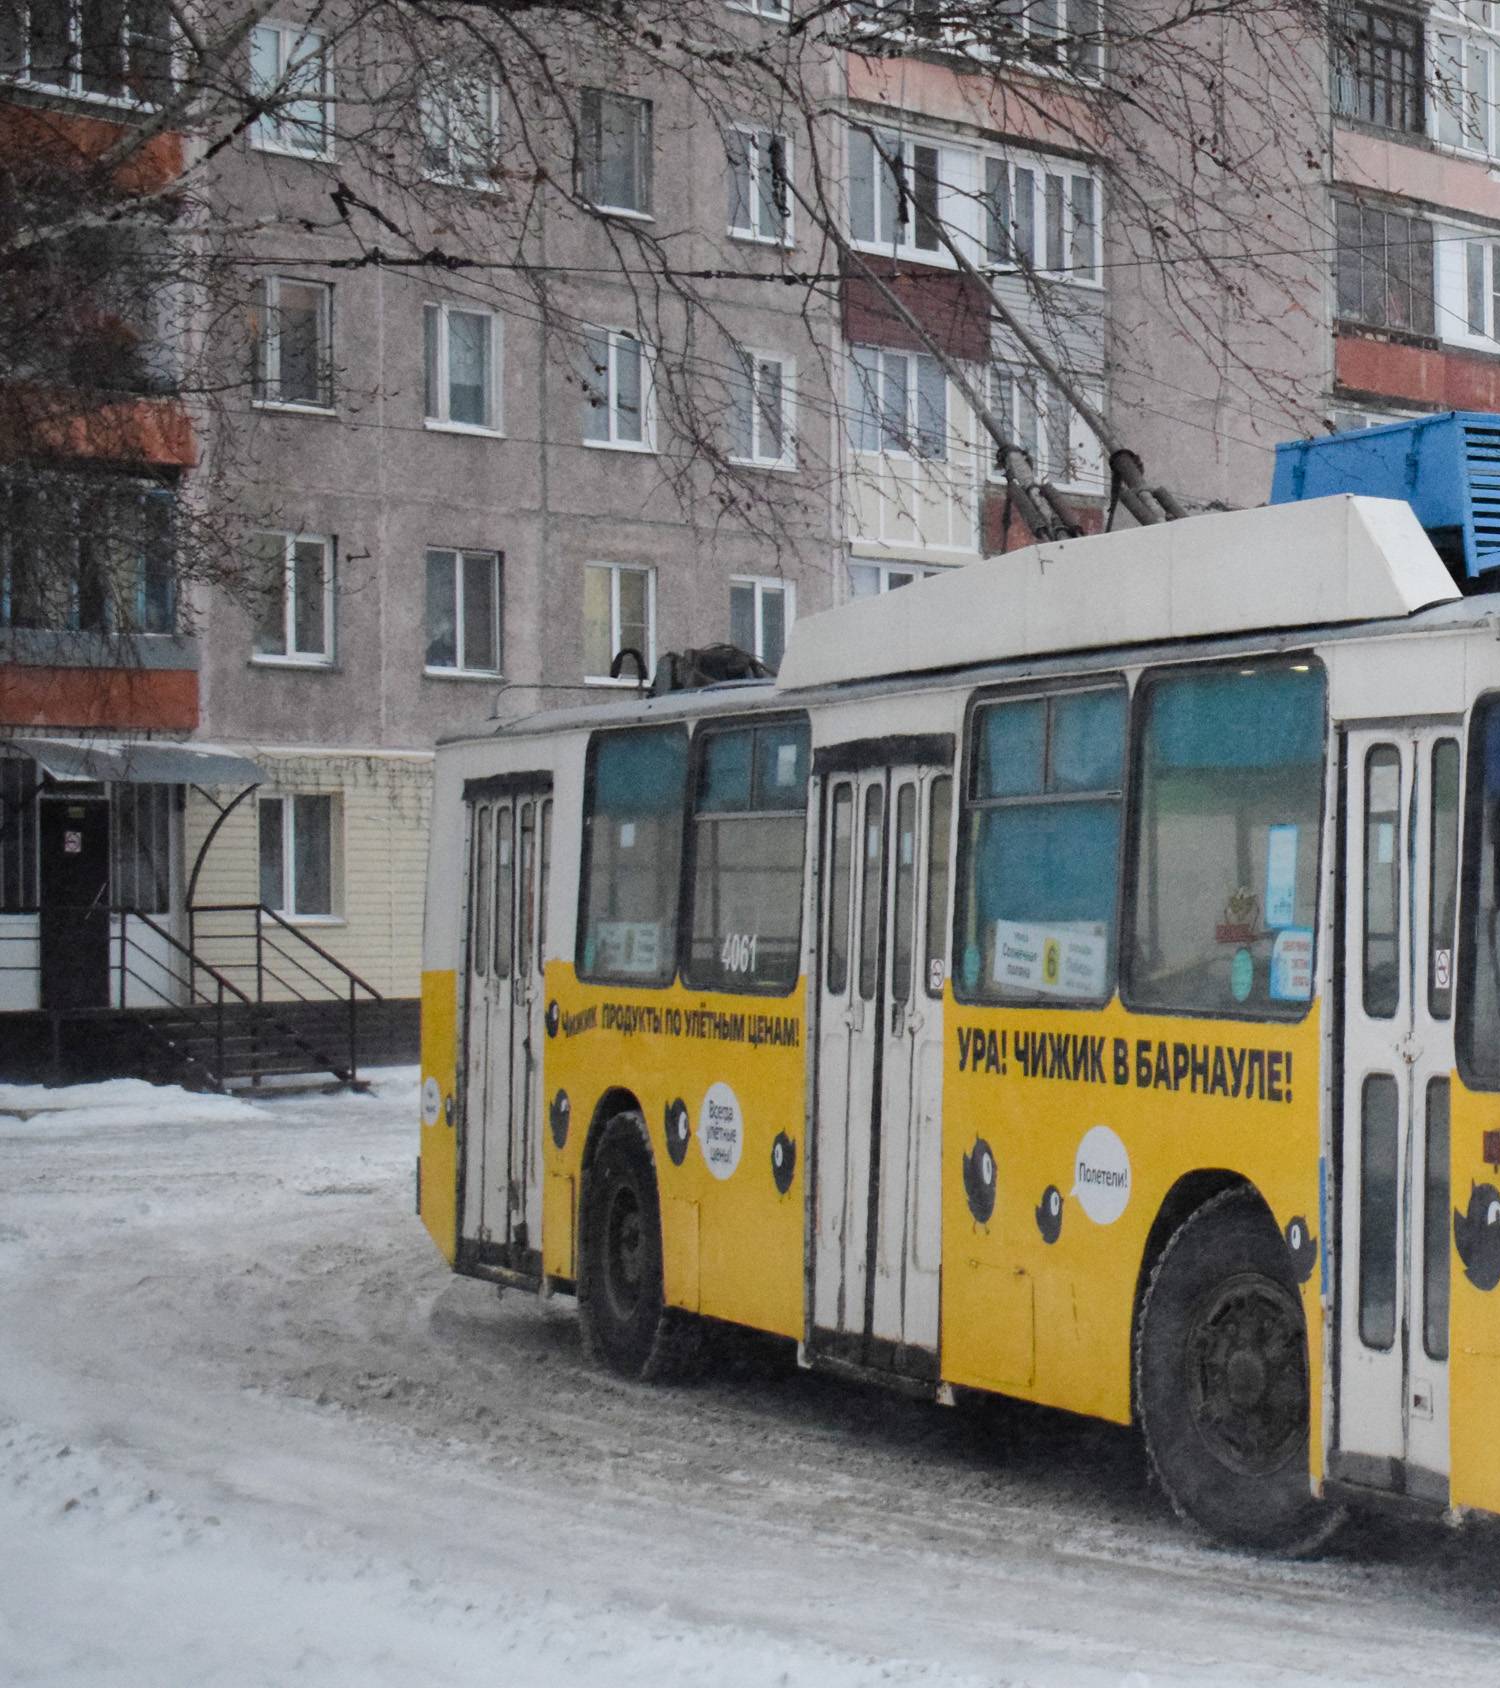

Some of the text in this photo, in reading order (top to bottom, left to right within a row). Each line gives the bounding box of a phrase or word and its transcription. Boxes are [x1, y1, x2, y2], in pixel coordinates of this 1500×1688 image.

[721, 933, 758, 973] 4061
[602, 1003, 664, 1037] ПРОДУКТЫ
[666, 1008, 681, 1037] ПО
[684, 1002, 745, 1043] УЛЁТНЫМ
[748, 1014, 799, 1050] ЦЕНАМ!
[957, 1026, 1293, 1104] УРА! ЧИЖИК В БАРНАУЛЕ!
[1079, 1162, 1128, 1189] Полетели!
